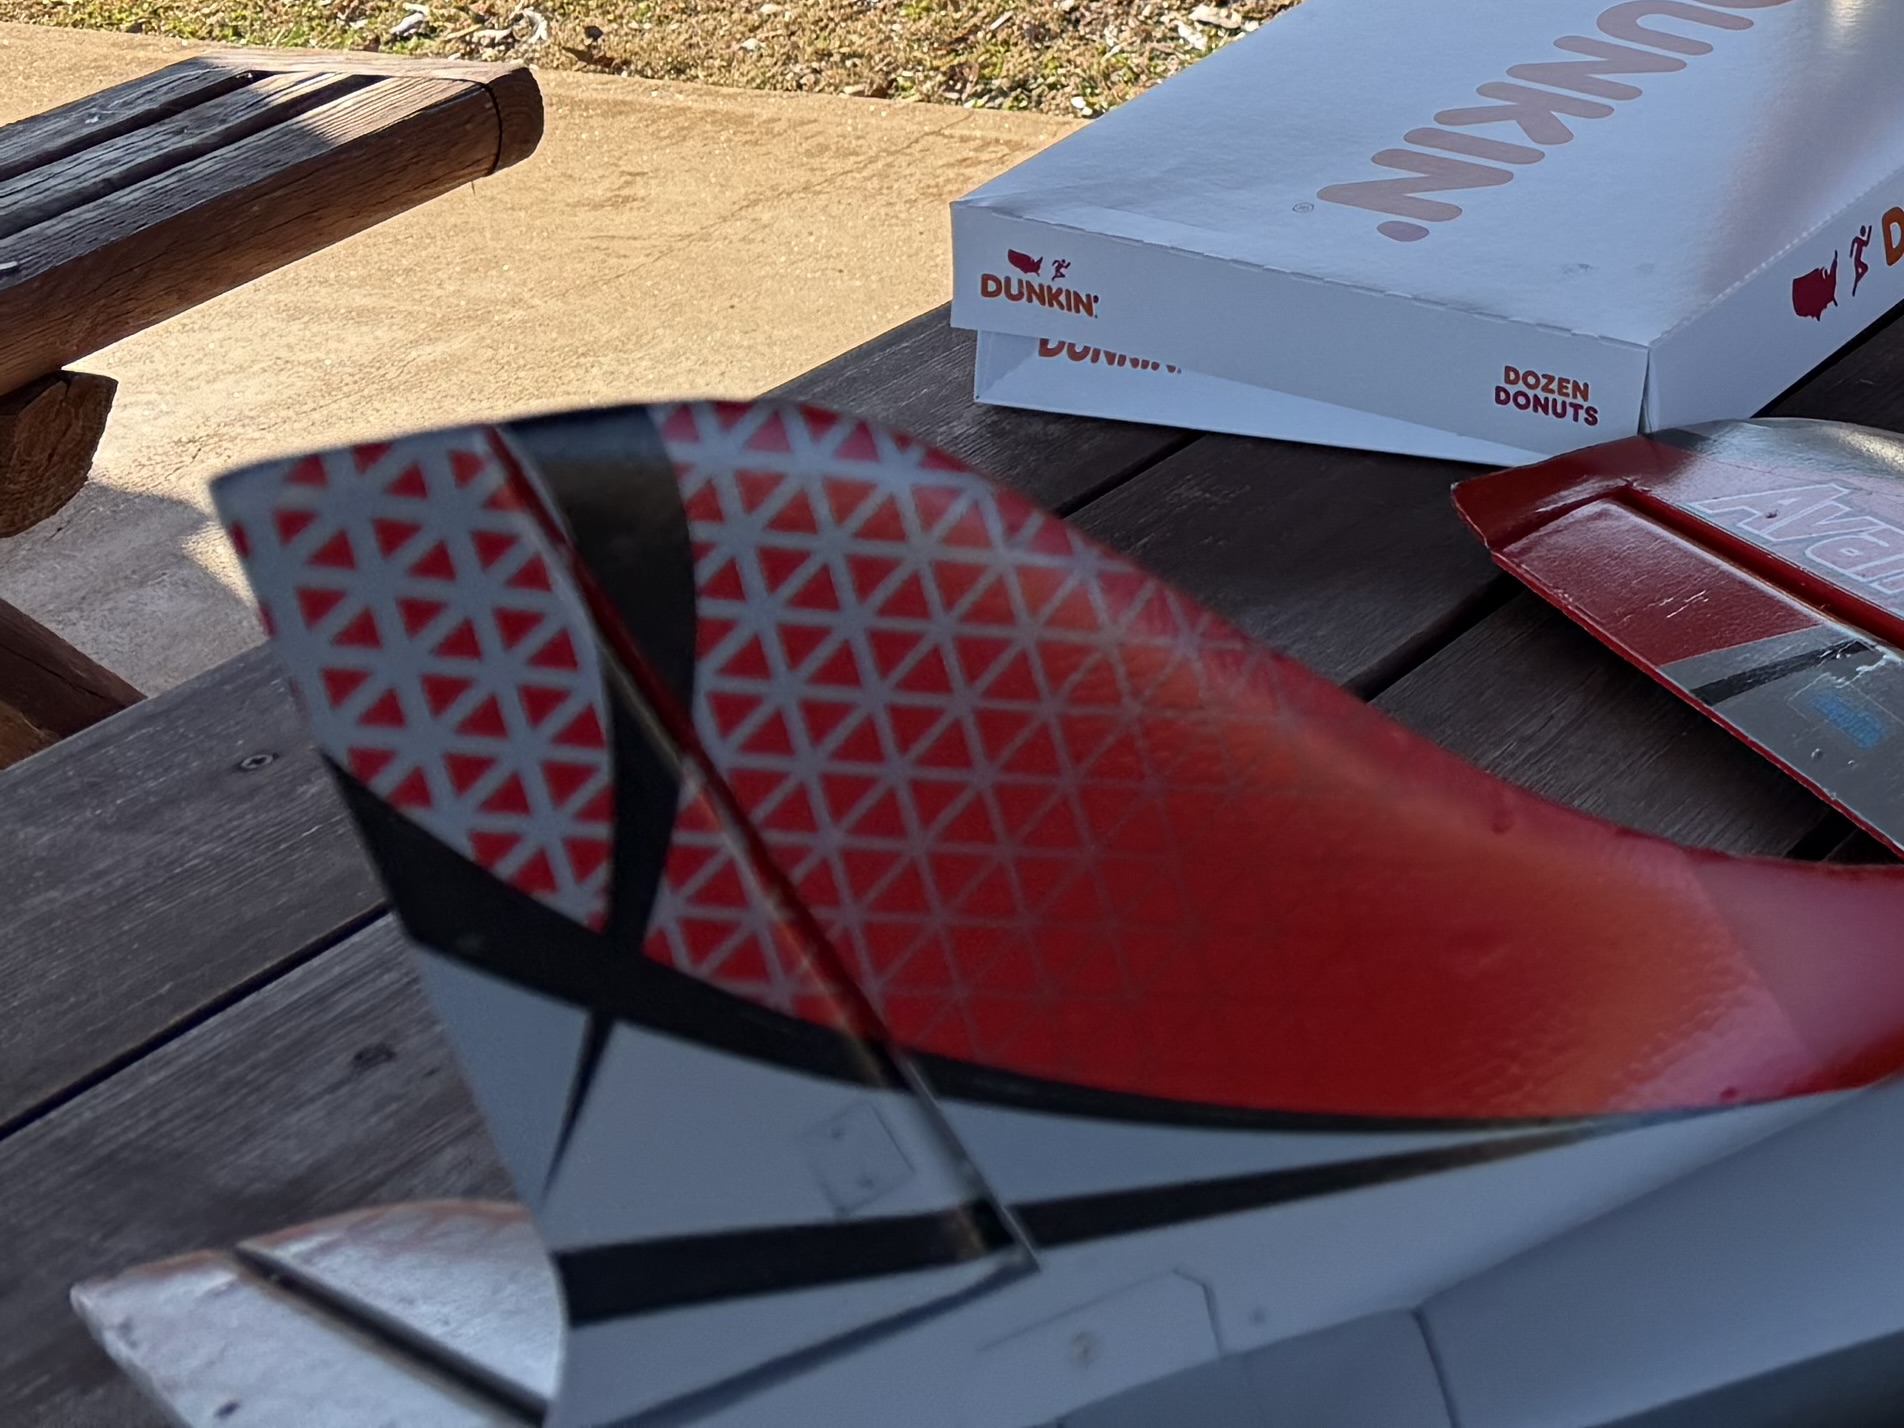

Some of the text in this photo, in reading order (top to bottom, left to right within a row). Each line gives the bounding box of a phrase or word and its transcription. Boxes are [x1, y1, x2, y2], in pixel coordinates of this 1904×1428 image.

[980, 273, 1099, 317] DUNKIN'
[1504, 365, 1590, 402] DOZEN
[1495, 385, 1598, 426] DONUTS
